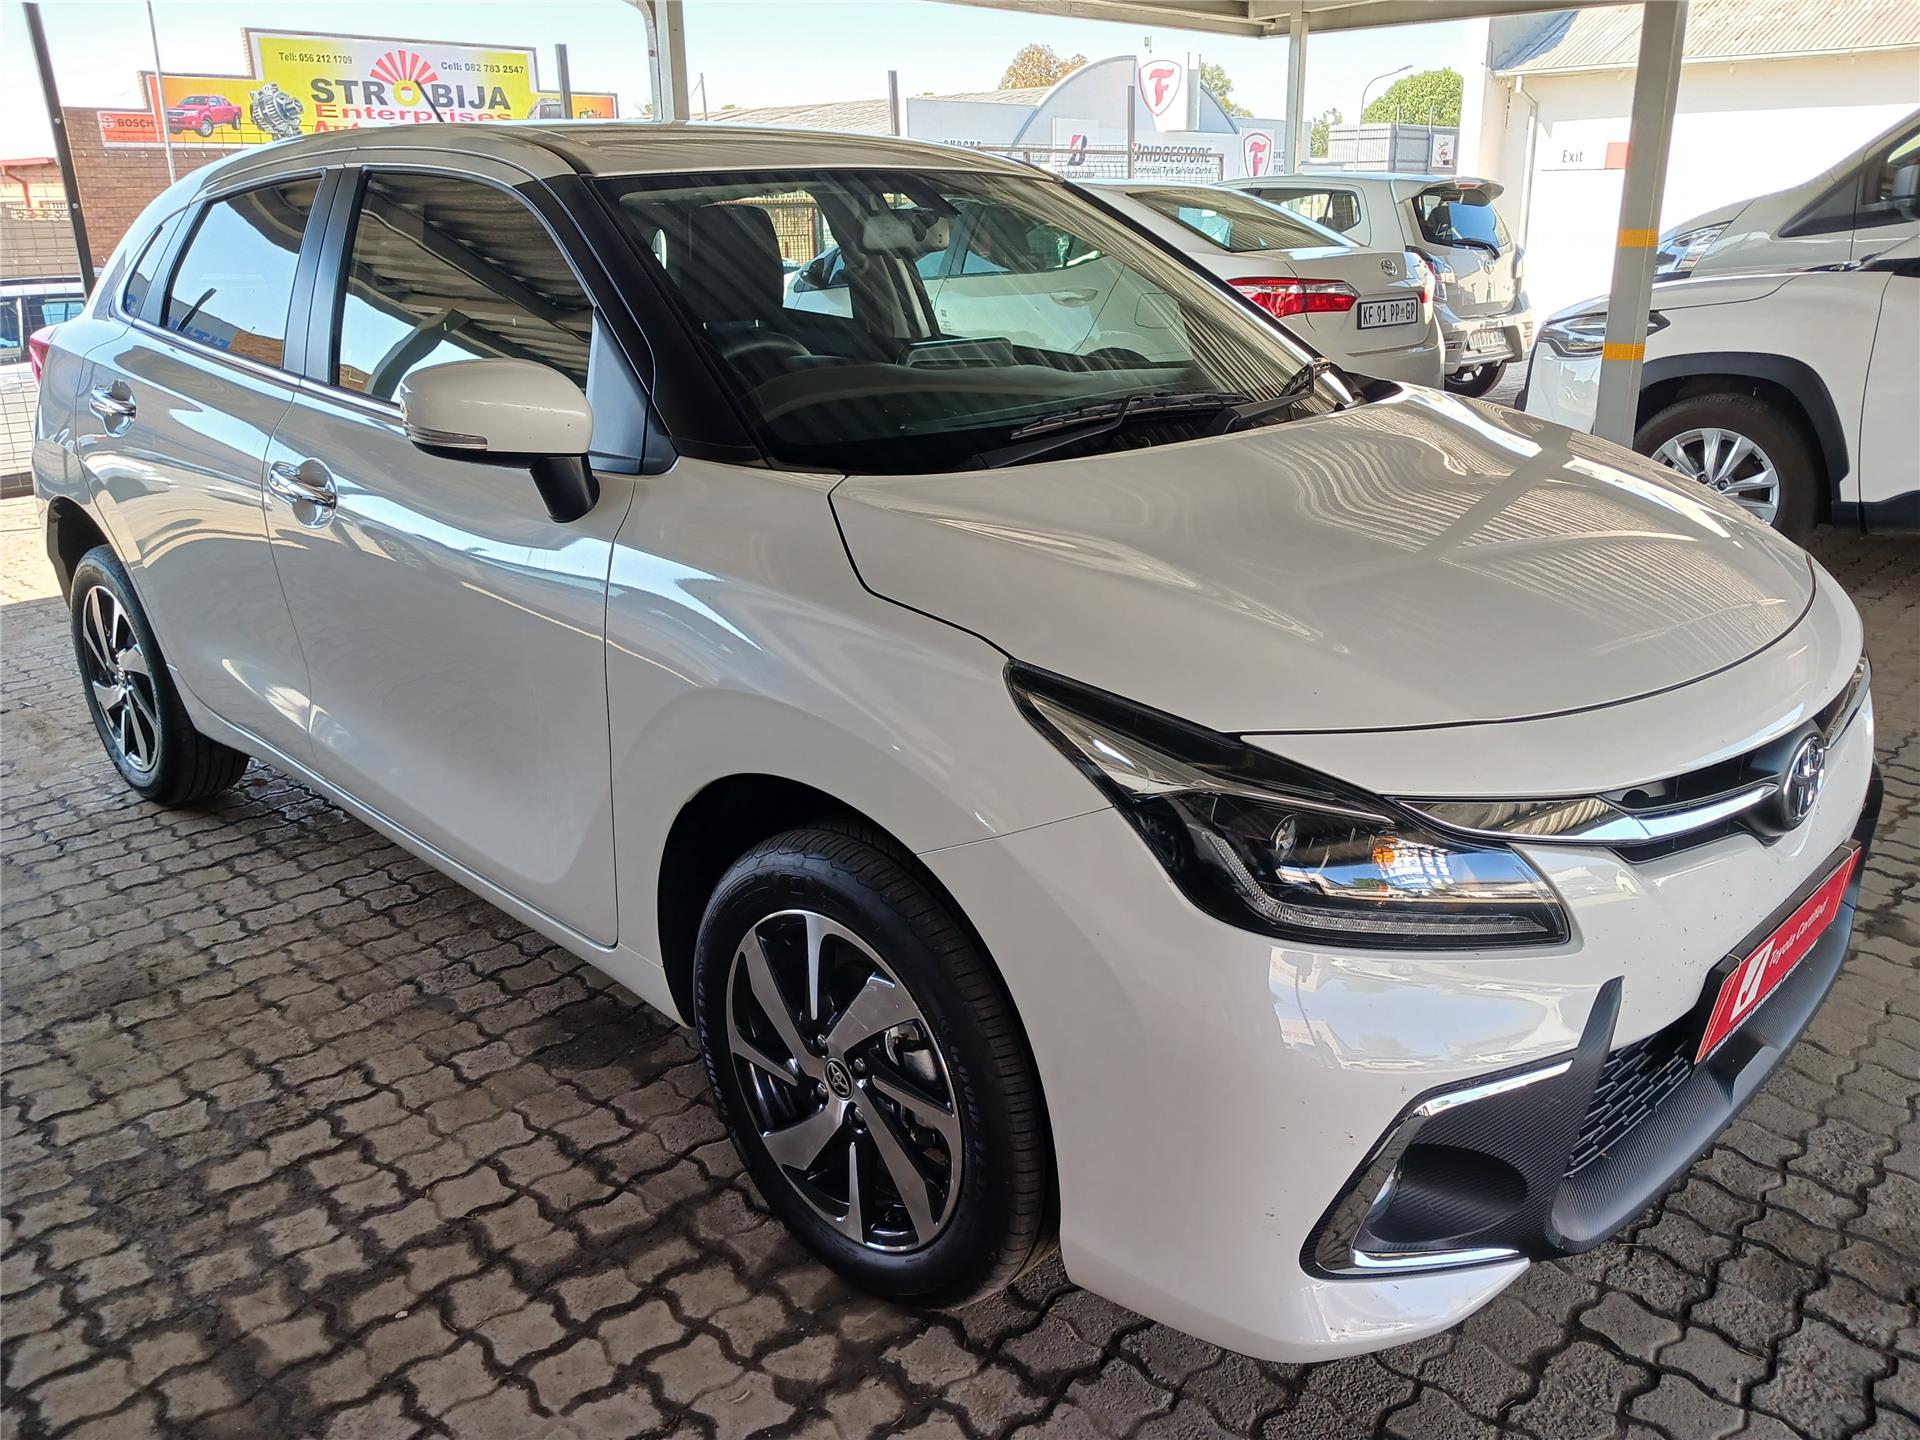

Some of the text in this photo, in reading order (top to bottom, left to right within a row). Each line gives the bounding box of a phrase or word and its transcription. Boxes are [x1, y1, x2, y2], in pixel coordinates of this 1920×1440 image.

[278, 51, 353, 65] Tell: 056 212 1709
[440, 61, 525, 75] Cell: 082 783 2547
[310, 78, 511, 110] STROBIJA
[315, 103, 512, 123] Enterprises
[117, 118, 155, 128] BOSCH
[1130, 143, 1213, 163] BRIDGESTONE
[1562, 149, 1583, 163] Exit
[1133, 166, 1162, 175] ommercial
[1163, 166, 1175, 177] Tyre
[1175, 167, 1195, 175] Service
[1363, 302, 1416, 325] KF 91 PP GP
